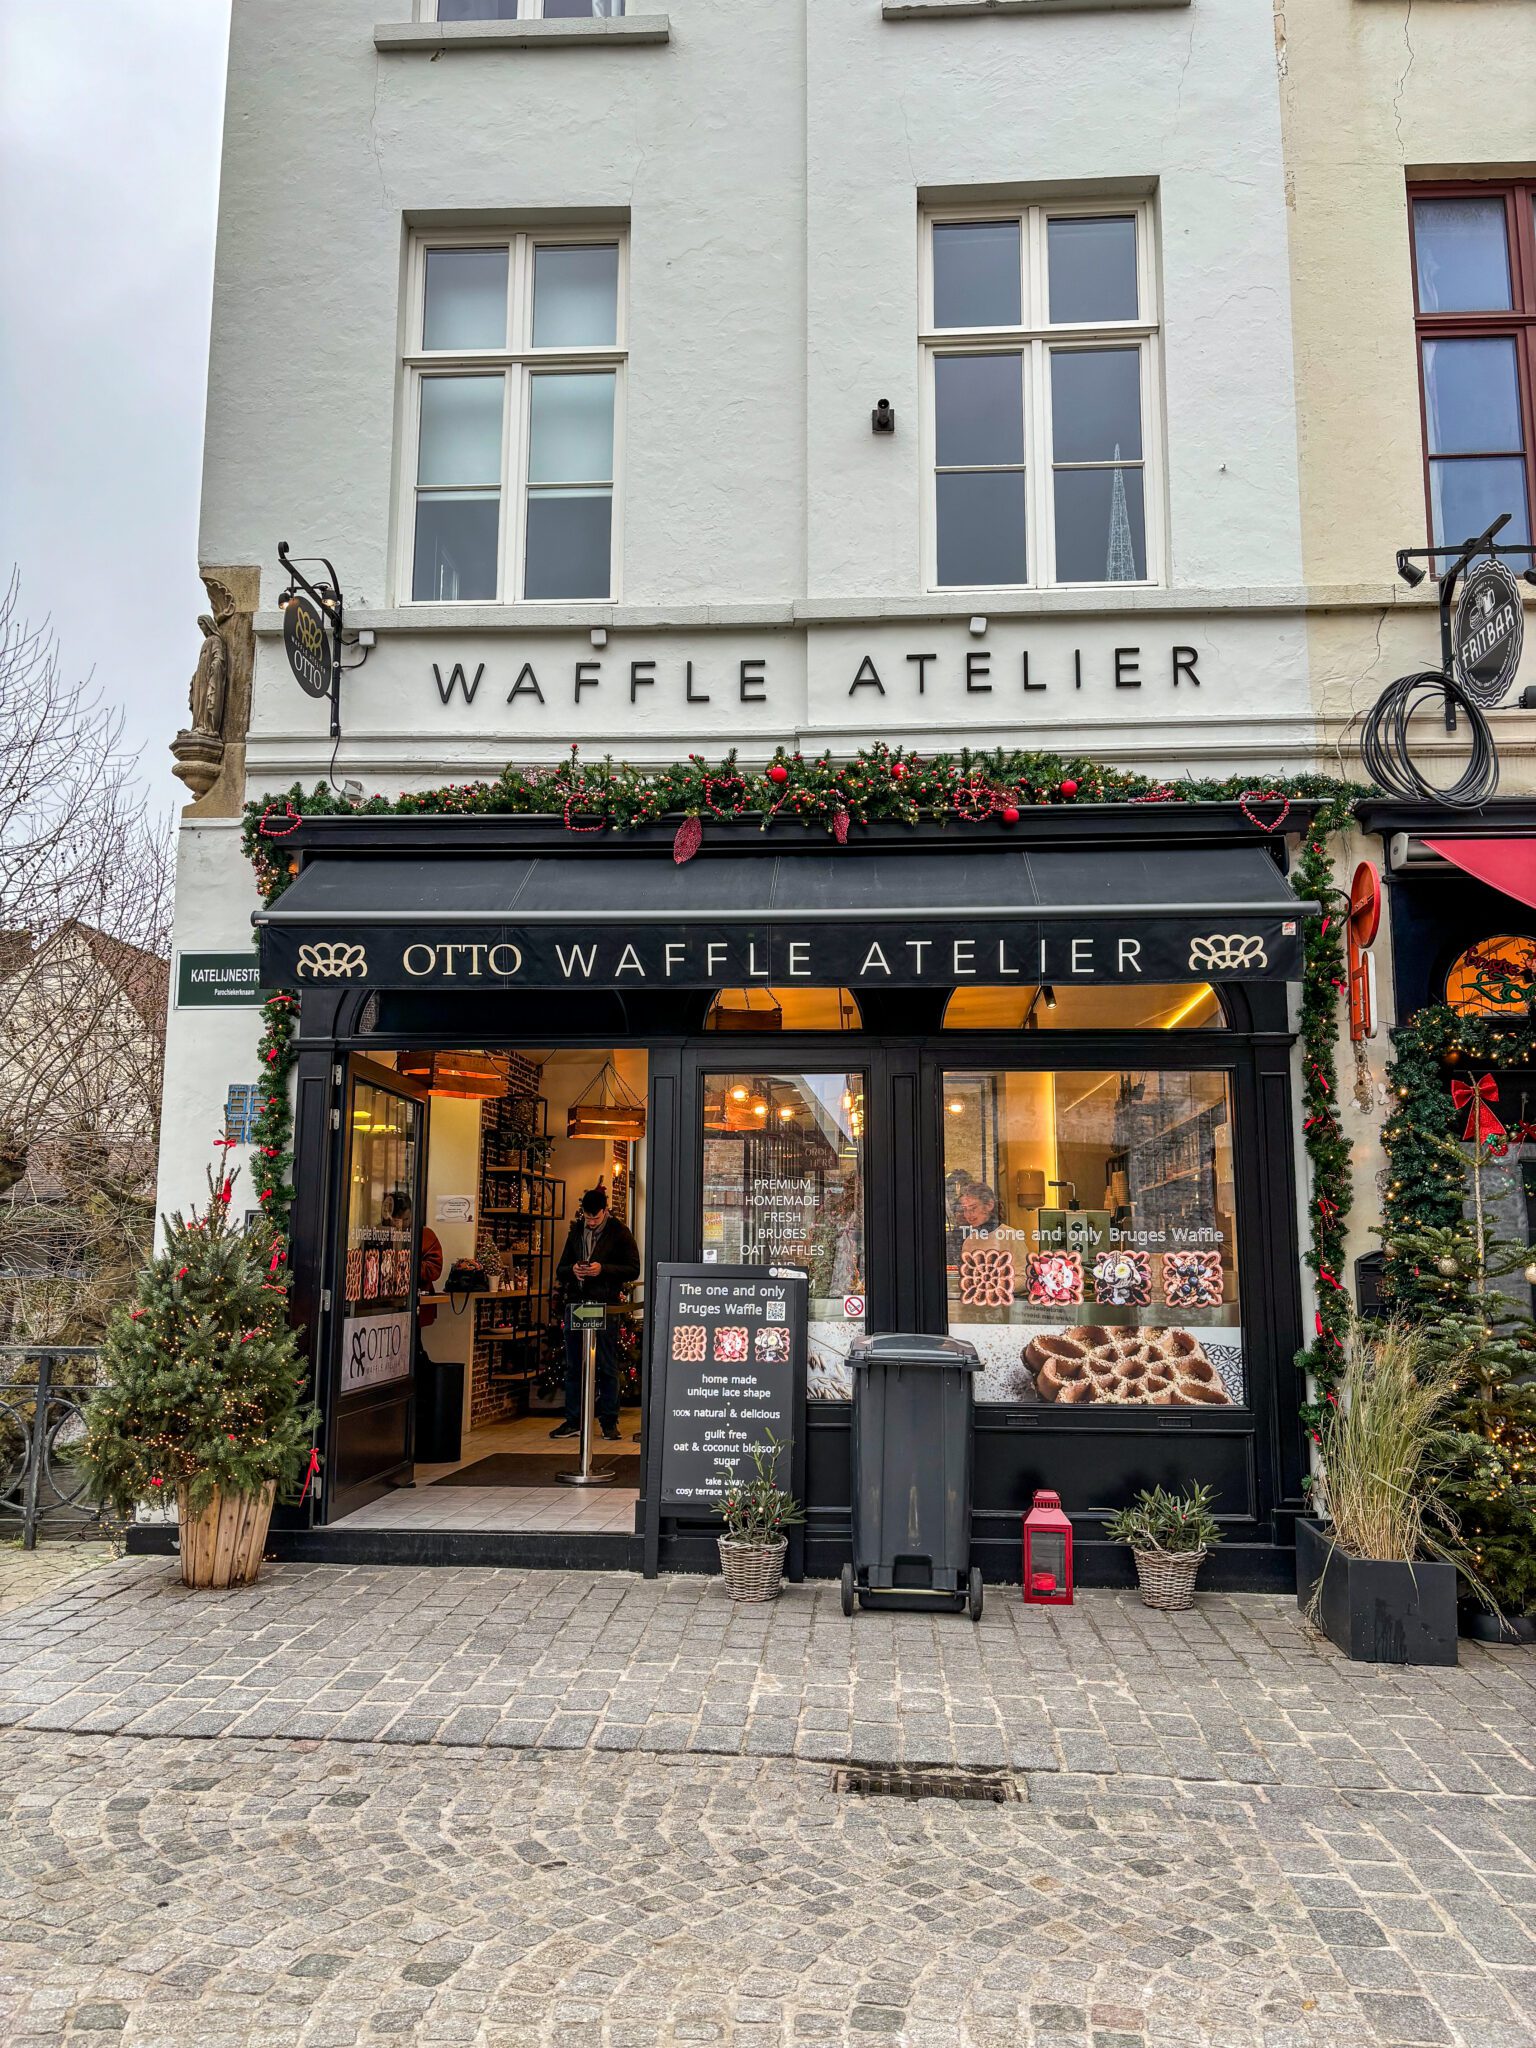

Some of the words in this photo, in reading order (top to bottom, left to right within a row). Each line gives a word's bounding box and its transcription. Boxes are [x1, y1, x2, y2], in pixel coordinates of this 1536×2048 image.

[1461, 604, 1515, 669] FRITBAR
[294, 650, 322, 690] OTTO
[432, 659, 767, 705] WAFFLE
[848, 645, 1202, 697] ATELIER
[402, 942, 523, 976] OTTO
[555, 940, 813, 979] WAFFLE
[859, 937, 1143, 977] ATELIER
[190, 968, 260, 983] KATELIJNESTR
[214, 988, 255, 996] Parochiekerknaam
[754, 1179, 811, 1190] PREMIUM
[745, 1195, 820, 1206] HOMEMADE
[763, 1212, 801, 1223] FRESH
[758, 1228, 807, 1239] BRUGES
[958, 1225, 989, 1241] The
[995, 1228, 1025, 1242] one
[1031, 1226, 1062, 1242] and
[1067, 1226, 1103, 1246] only
[1109, 1227, 1167, 1246] Bruges
[1171, 1226, 1225, 1243] Waffle
[740, 1244, 766, 1256] OAT
[769, 1245, 824, 1256] WAFFLES
[679, 1283, 702, 1295] The
[705, 1286, 729, 1296] one
[732, 1284, 756, 1297] and
[759, 1285, 786, 1300] only
[678, 1302, 721, 1317] Bruges
[724, 1303, 763, 1316] Waffle
[582, 1319, 604, 1328] order
[367, 1324, 402, 1361] OTTO
[702, 1374, 728, 1384] home
[731, 1375, 758, 1385] made
[687, 1387, 719, 1399] unique
[722, 1387, 741, 1397] lace
[743, 1388, 771, 1400] shape
[672, 1409, 691, 1417] 100%
[693, 1408, 727, 1418] natural
[729, 1409, 738, 1418] &
[740, 1409, 781, 1419] delicious
[704, 1429, 726, 1441] guilt
[728, 1429, 748, 1440] free
[673, 1443, 689, 1452] oat
[691, 1442, 700, 1452] &
[702, 1443, 740, 1453] coconut
[713, 1458, 740, 1467] sugar
[705, 1477, 722, 1486] take
[675, 1487, 693, 1497] cosy
[695, 1487, 723, 1496] terrace
